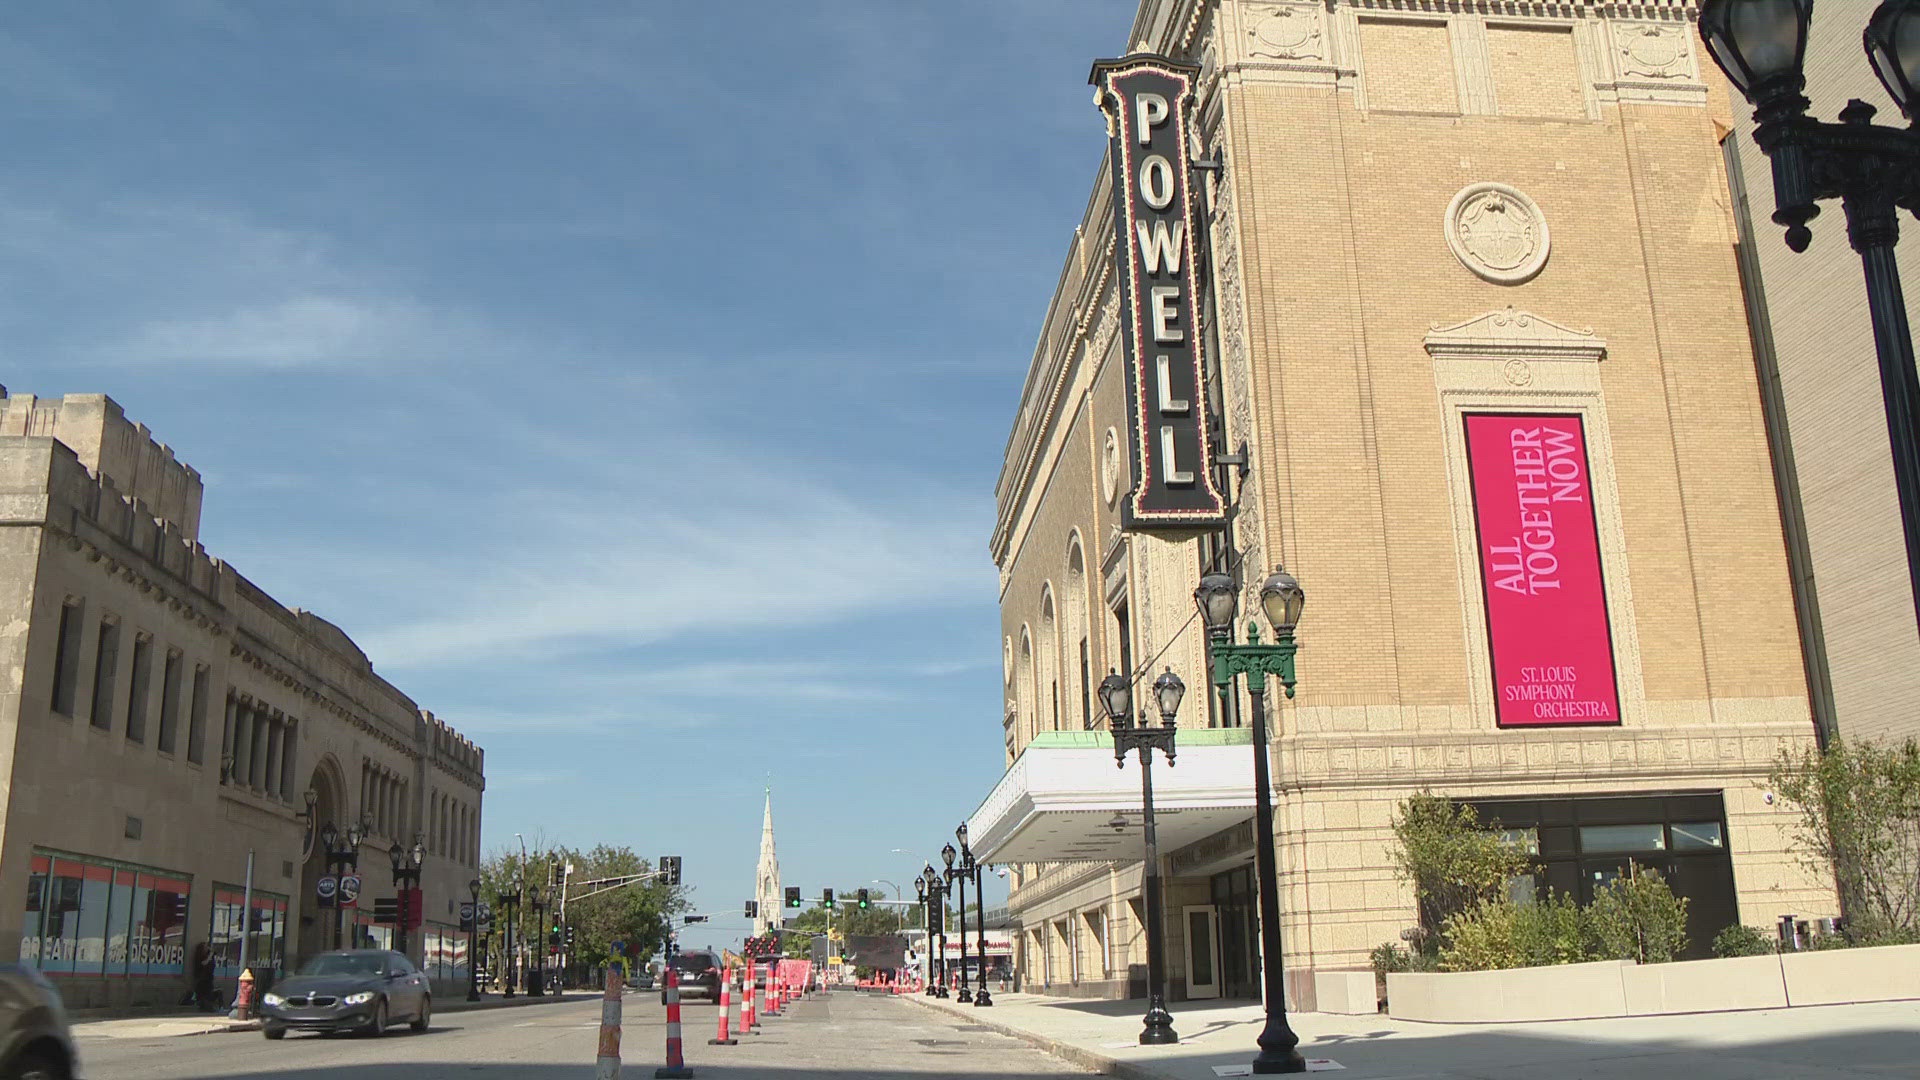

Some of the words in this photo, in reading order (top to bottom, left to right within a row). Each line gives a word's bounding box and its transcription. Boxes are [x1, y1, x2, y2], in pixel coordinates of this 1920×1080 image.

[1135, 92, 1195, 485] POWELL
[1542, 426, 1583, 503] NOW
[1510, 427, 1561, 595] TOGETHER
[1490, 536, 1527, 595] ALL
[1505, 684, 1575, 701] SYMPHONY
[1540, 667, 1576, 682] LOUIS
[1534, 702, 1609, 718] ORCHESTRA
[131, 943, 184, 965] DISCOVER
